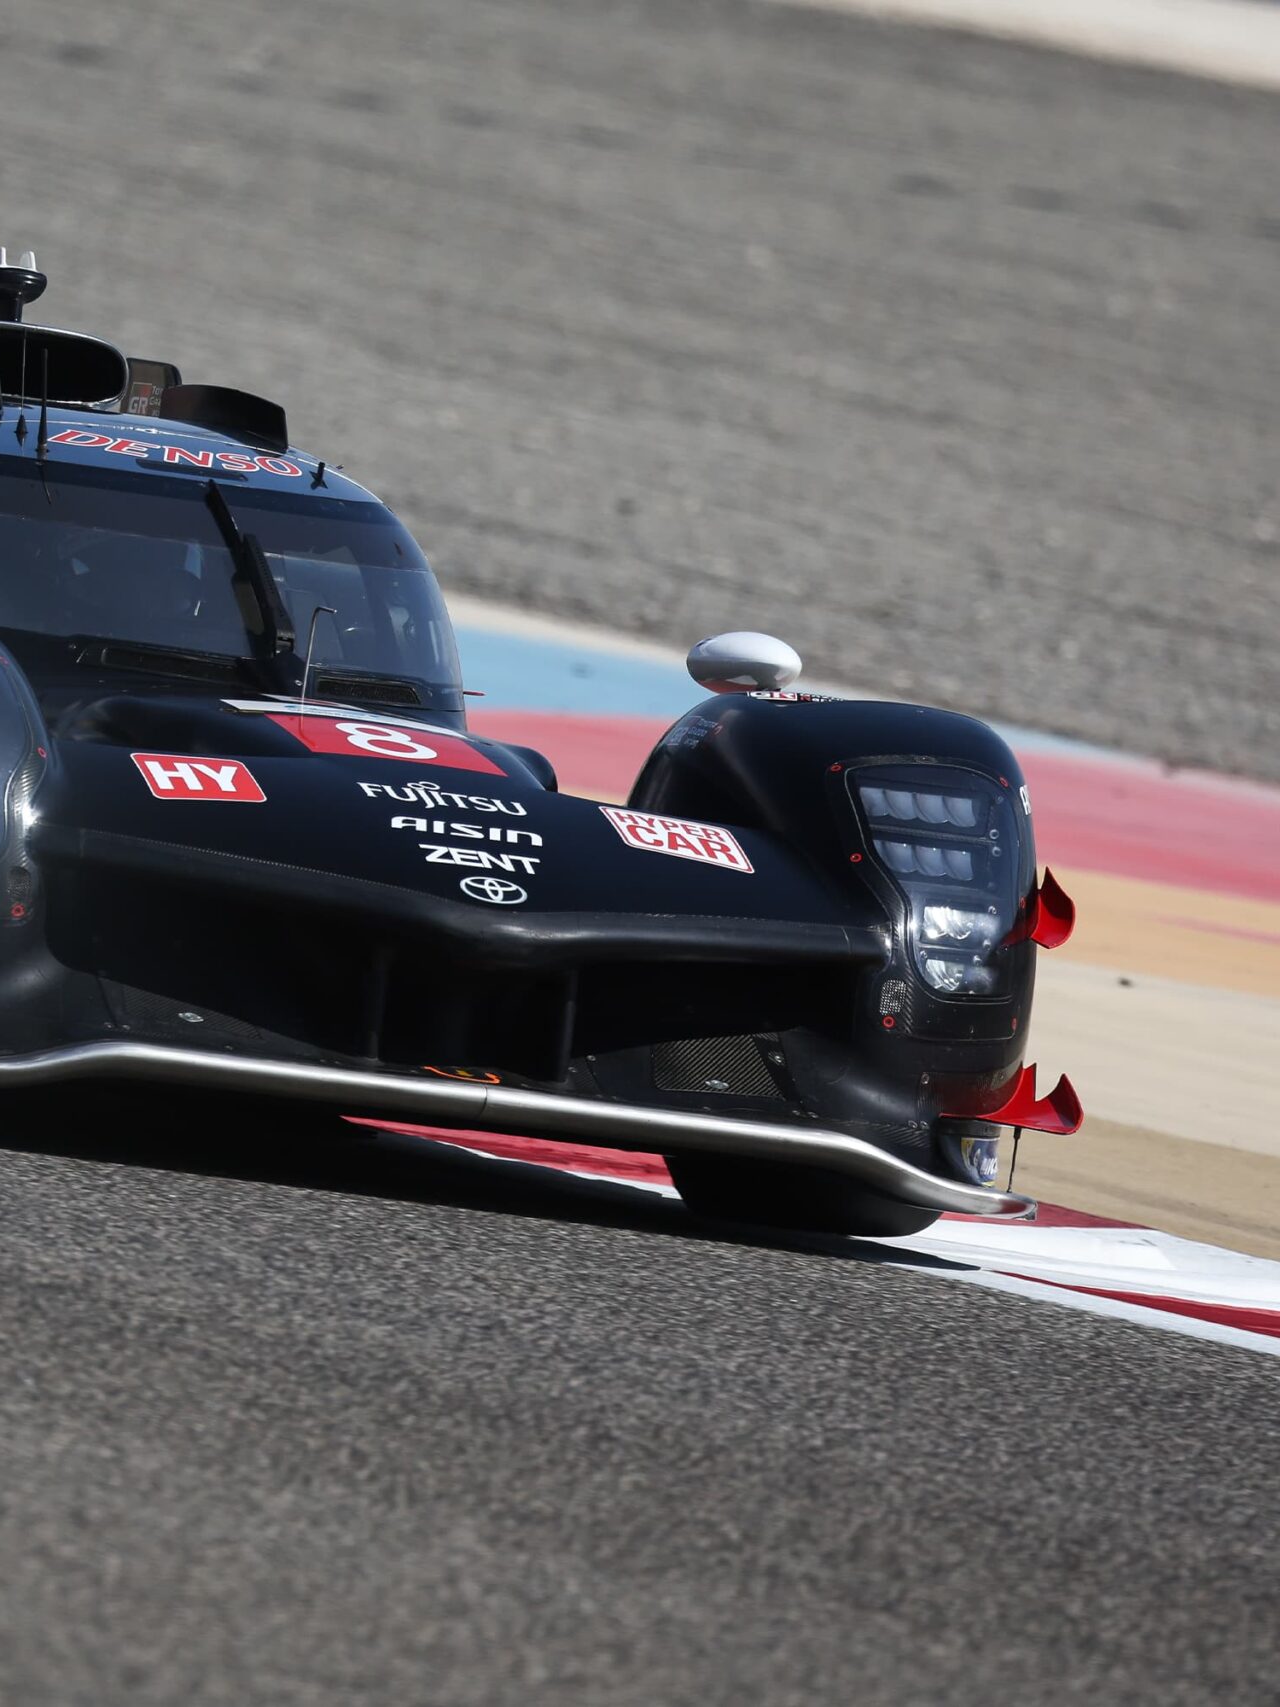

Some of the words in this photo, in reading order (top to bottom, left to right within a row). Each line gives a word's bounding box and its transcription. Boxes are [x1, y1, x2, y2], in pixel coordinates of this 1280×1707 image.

[47, 430, 303, 477] DENSO
[335, 722, 437, 759] 8
[143, 760, 238, 792] HY
[356, 781, 527, 816] FUJITSU
[391, 816, 543, 847] AISIN
[613, 811, 725, 842] HYPER
[418, 843, 541, 875] ZENT
[626, 824, 739, 865] CAR
